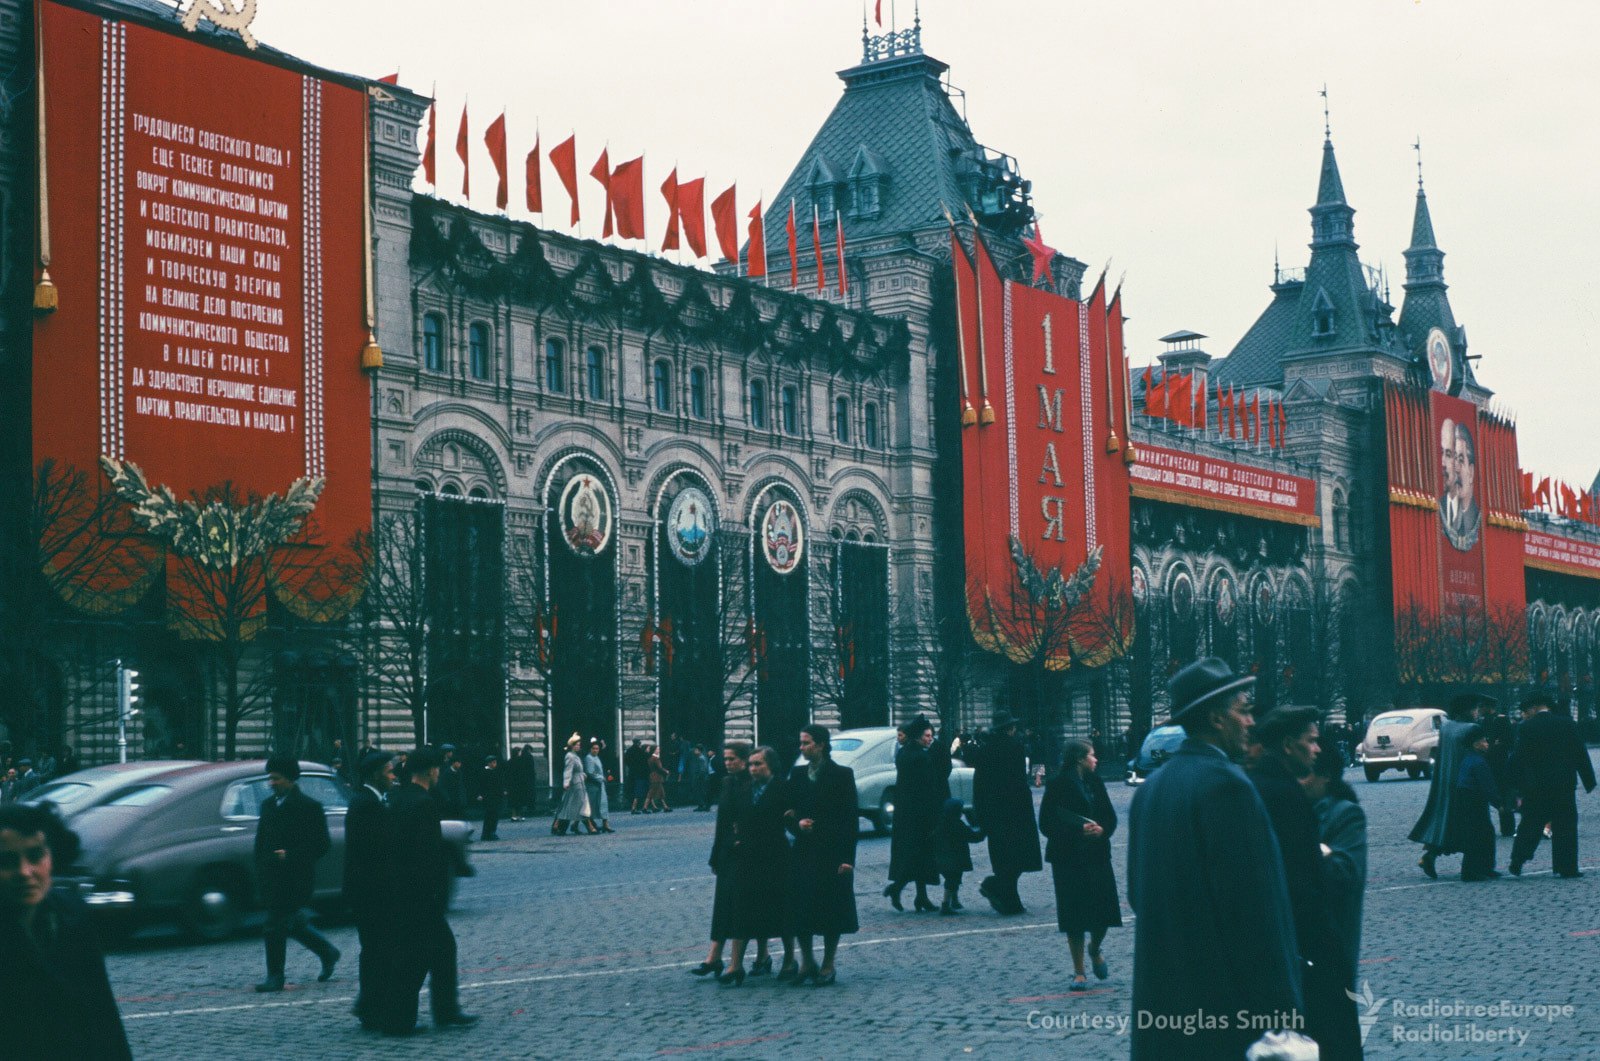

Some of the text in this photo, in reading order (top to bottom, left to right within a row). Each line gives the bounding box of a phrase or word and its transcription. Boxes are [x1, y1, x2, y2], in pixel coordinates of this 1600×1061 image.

[133, 113, 194, 145] ТРУДЯЩИЕСЯ
[199, 130, 251, 158] СОВЕТСКОГО
[152, 147, 274, 191] ЕЩЕ ТЕСНЕЕ СПЛОТИМСЯ
[137, 171, 288, 220] ВОКРУГ КОММУНИСТИЧЕСКОЙ ПАРТИИ
[140, 200, 290, 249] И СОВЕТСКОГО ПРАВИТЕЛЬСТВА,
[146, 229, 280, 272] МОБИЛИЗУЕМ НАШИ СИЛЫ
[147, 258, 281, 299] И ТВОРЧЕСКУЮ ЭНЕРГИЮ
[146, 285, 283, 325] НА ВЕЛИКОЕ ДЕЛО ПОСТРОЕНИЯ
[140, 312, 289, 353] КОММУНИСТИЧЕСКОГО ОБЩЕСТВА
[1041, 312, 1056, 375] 1
[163, 344, 169, 361] В
[177, 347, 214, 369] НАШЕЙ
[132, 368, 297, 407] ДА ЗДРАВСТВУЕТ НЕРУШИМОЕ ЕДИНЕНИЕ
[136, 396, 172, 419] ПАРТИИ,
[175, 401, 240, 427] ПРАВИТЕЛЬСТВА
[244, 411, 250, 427] И
[1136, 449, 1199, 473] ММУНИСТИЧЕСКАЯ
